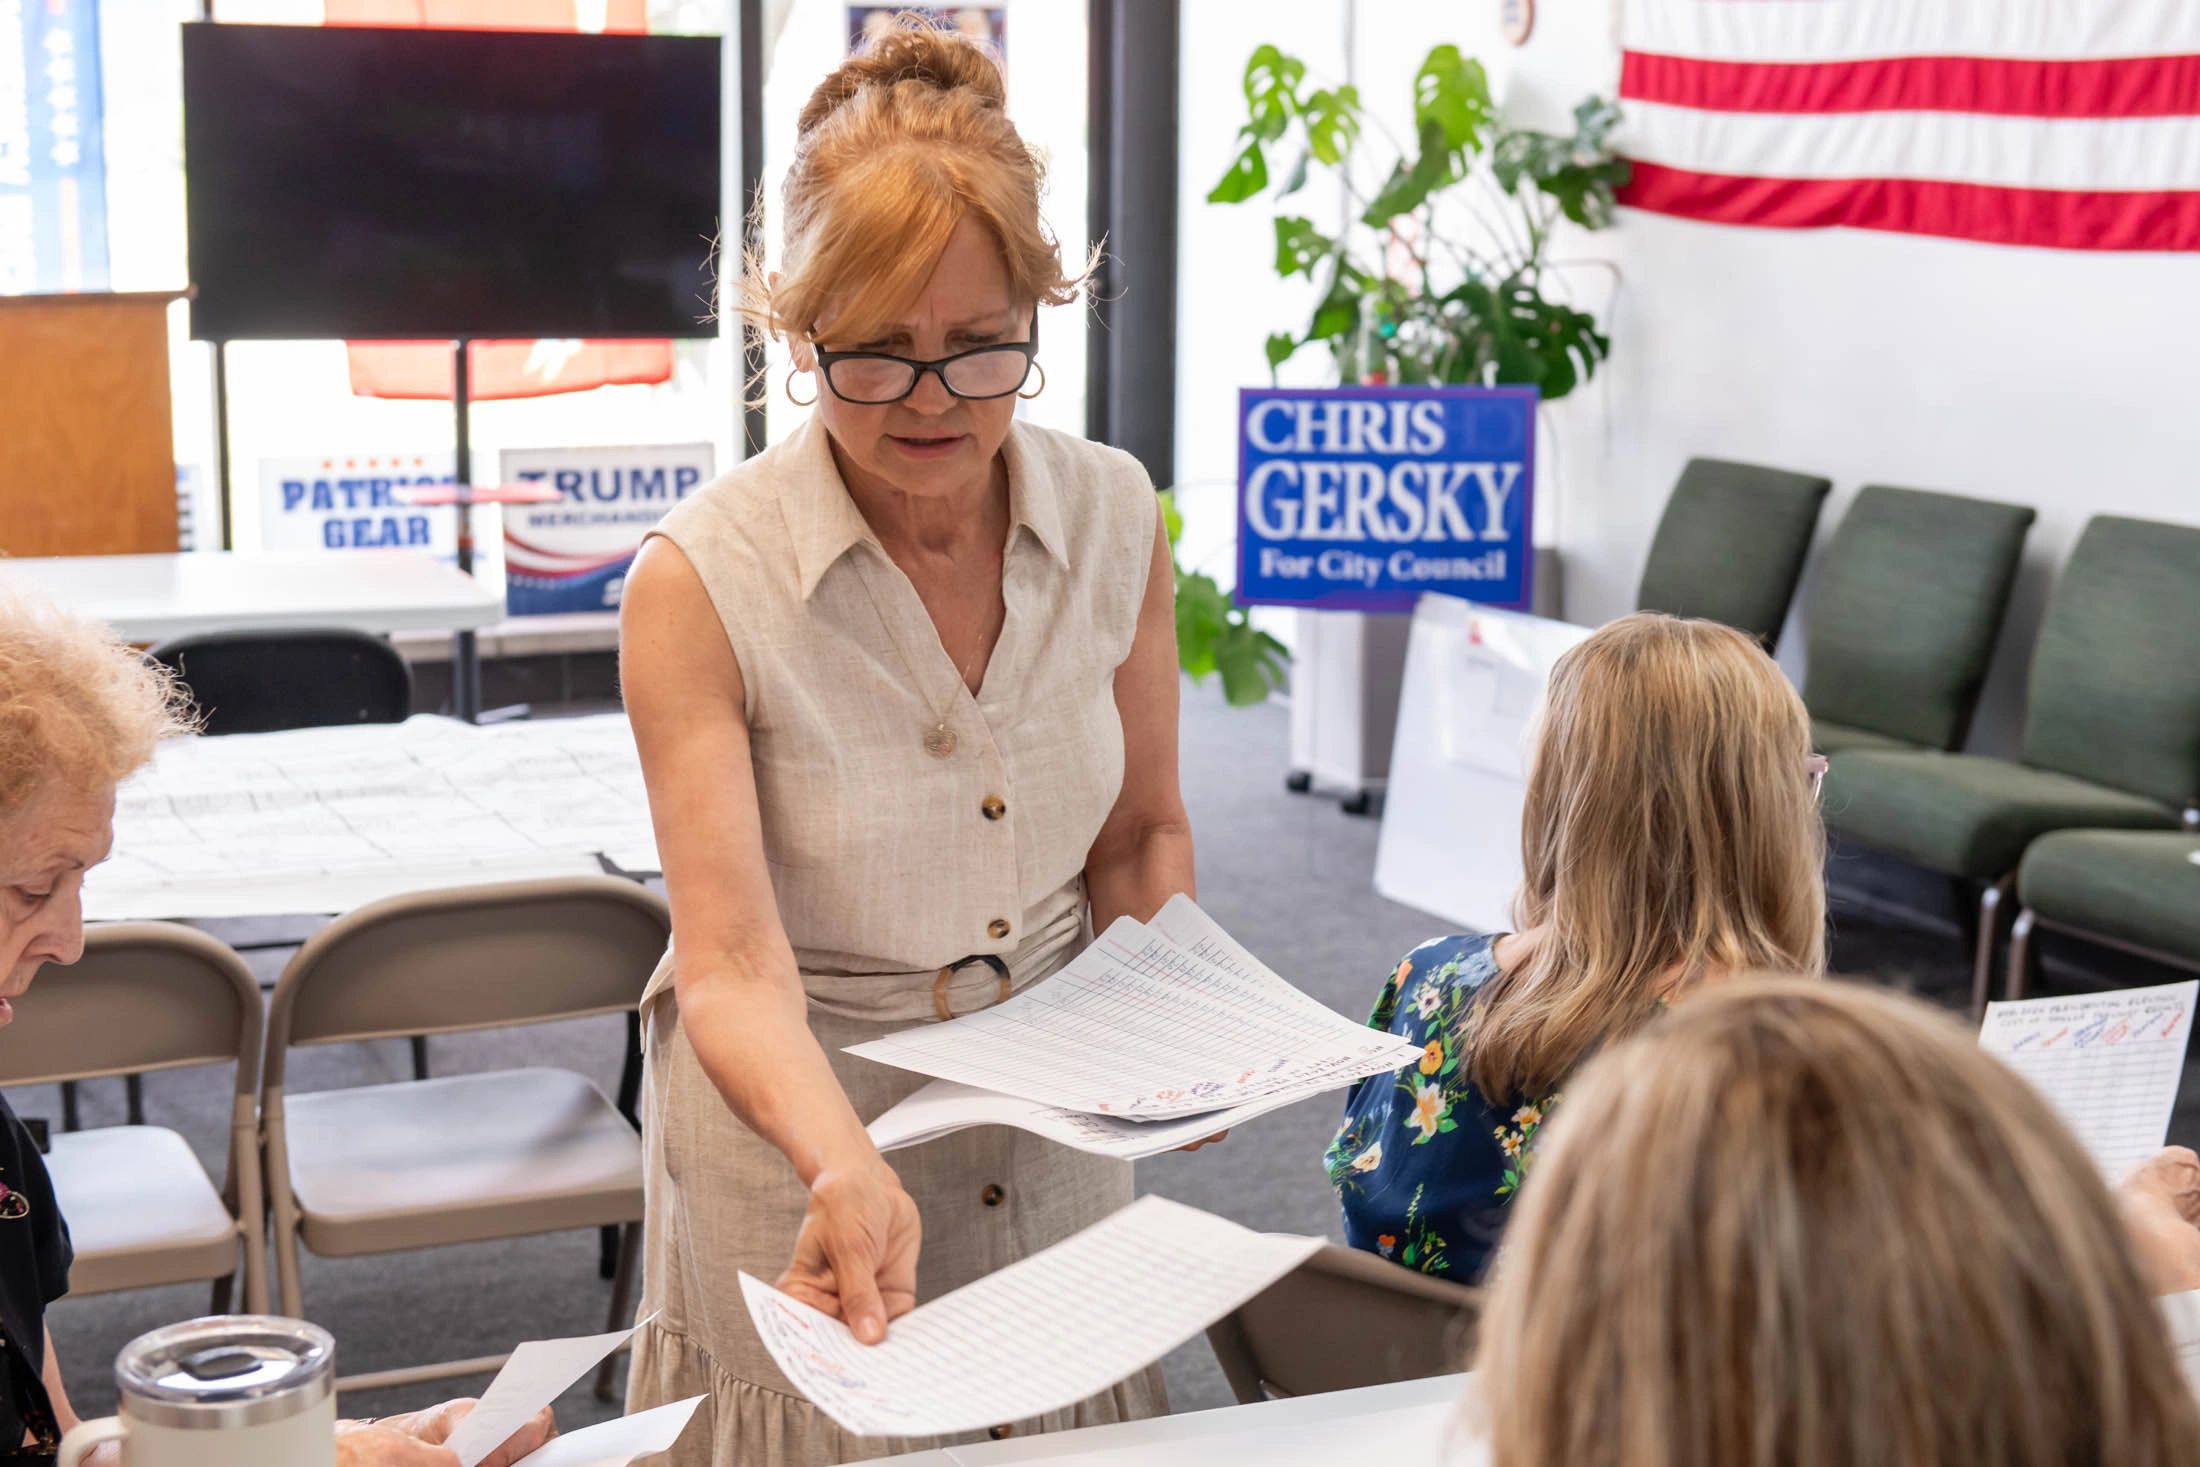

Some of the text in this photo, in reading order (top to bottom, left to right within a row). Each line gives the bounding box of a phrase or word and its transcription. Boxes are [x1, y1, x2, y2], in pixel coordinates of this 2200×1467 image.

[1246, 399, 1447, 454] CHRIS
[281, 473, 458, 512] PATR
[1244, 460, 1523, 543] GERSKY
[323, 516, 431, 549] GEAR
[1259, 547, 1507, 588] For City Council
